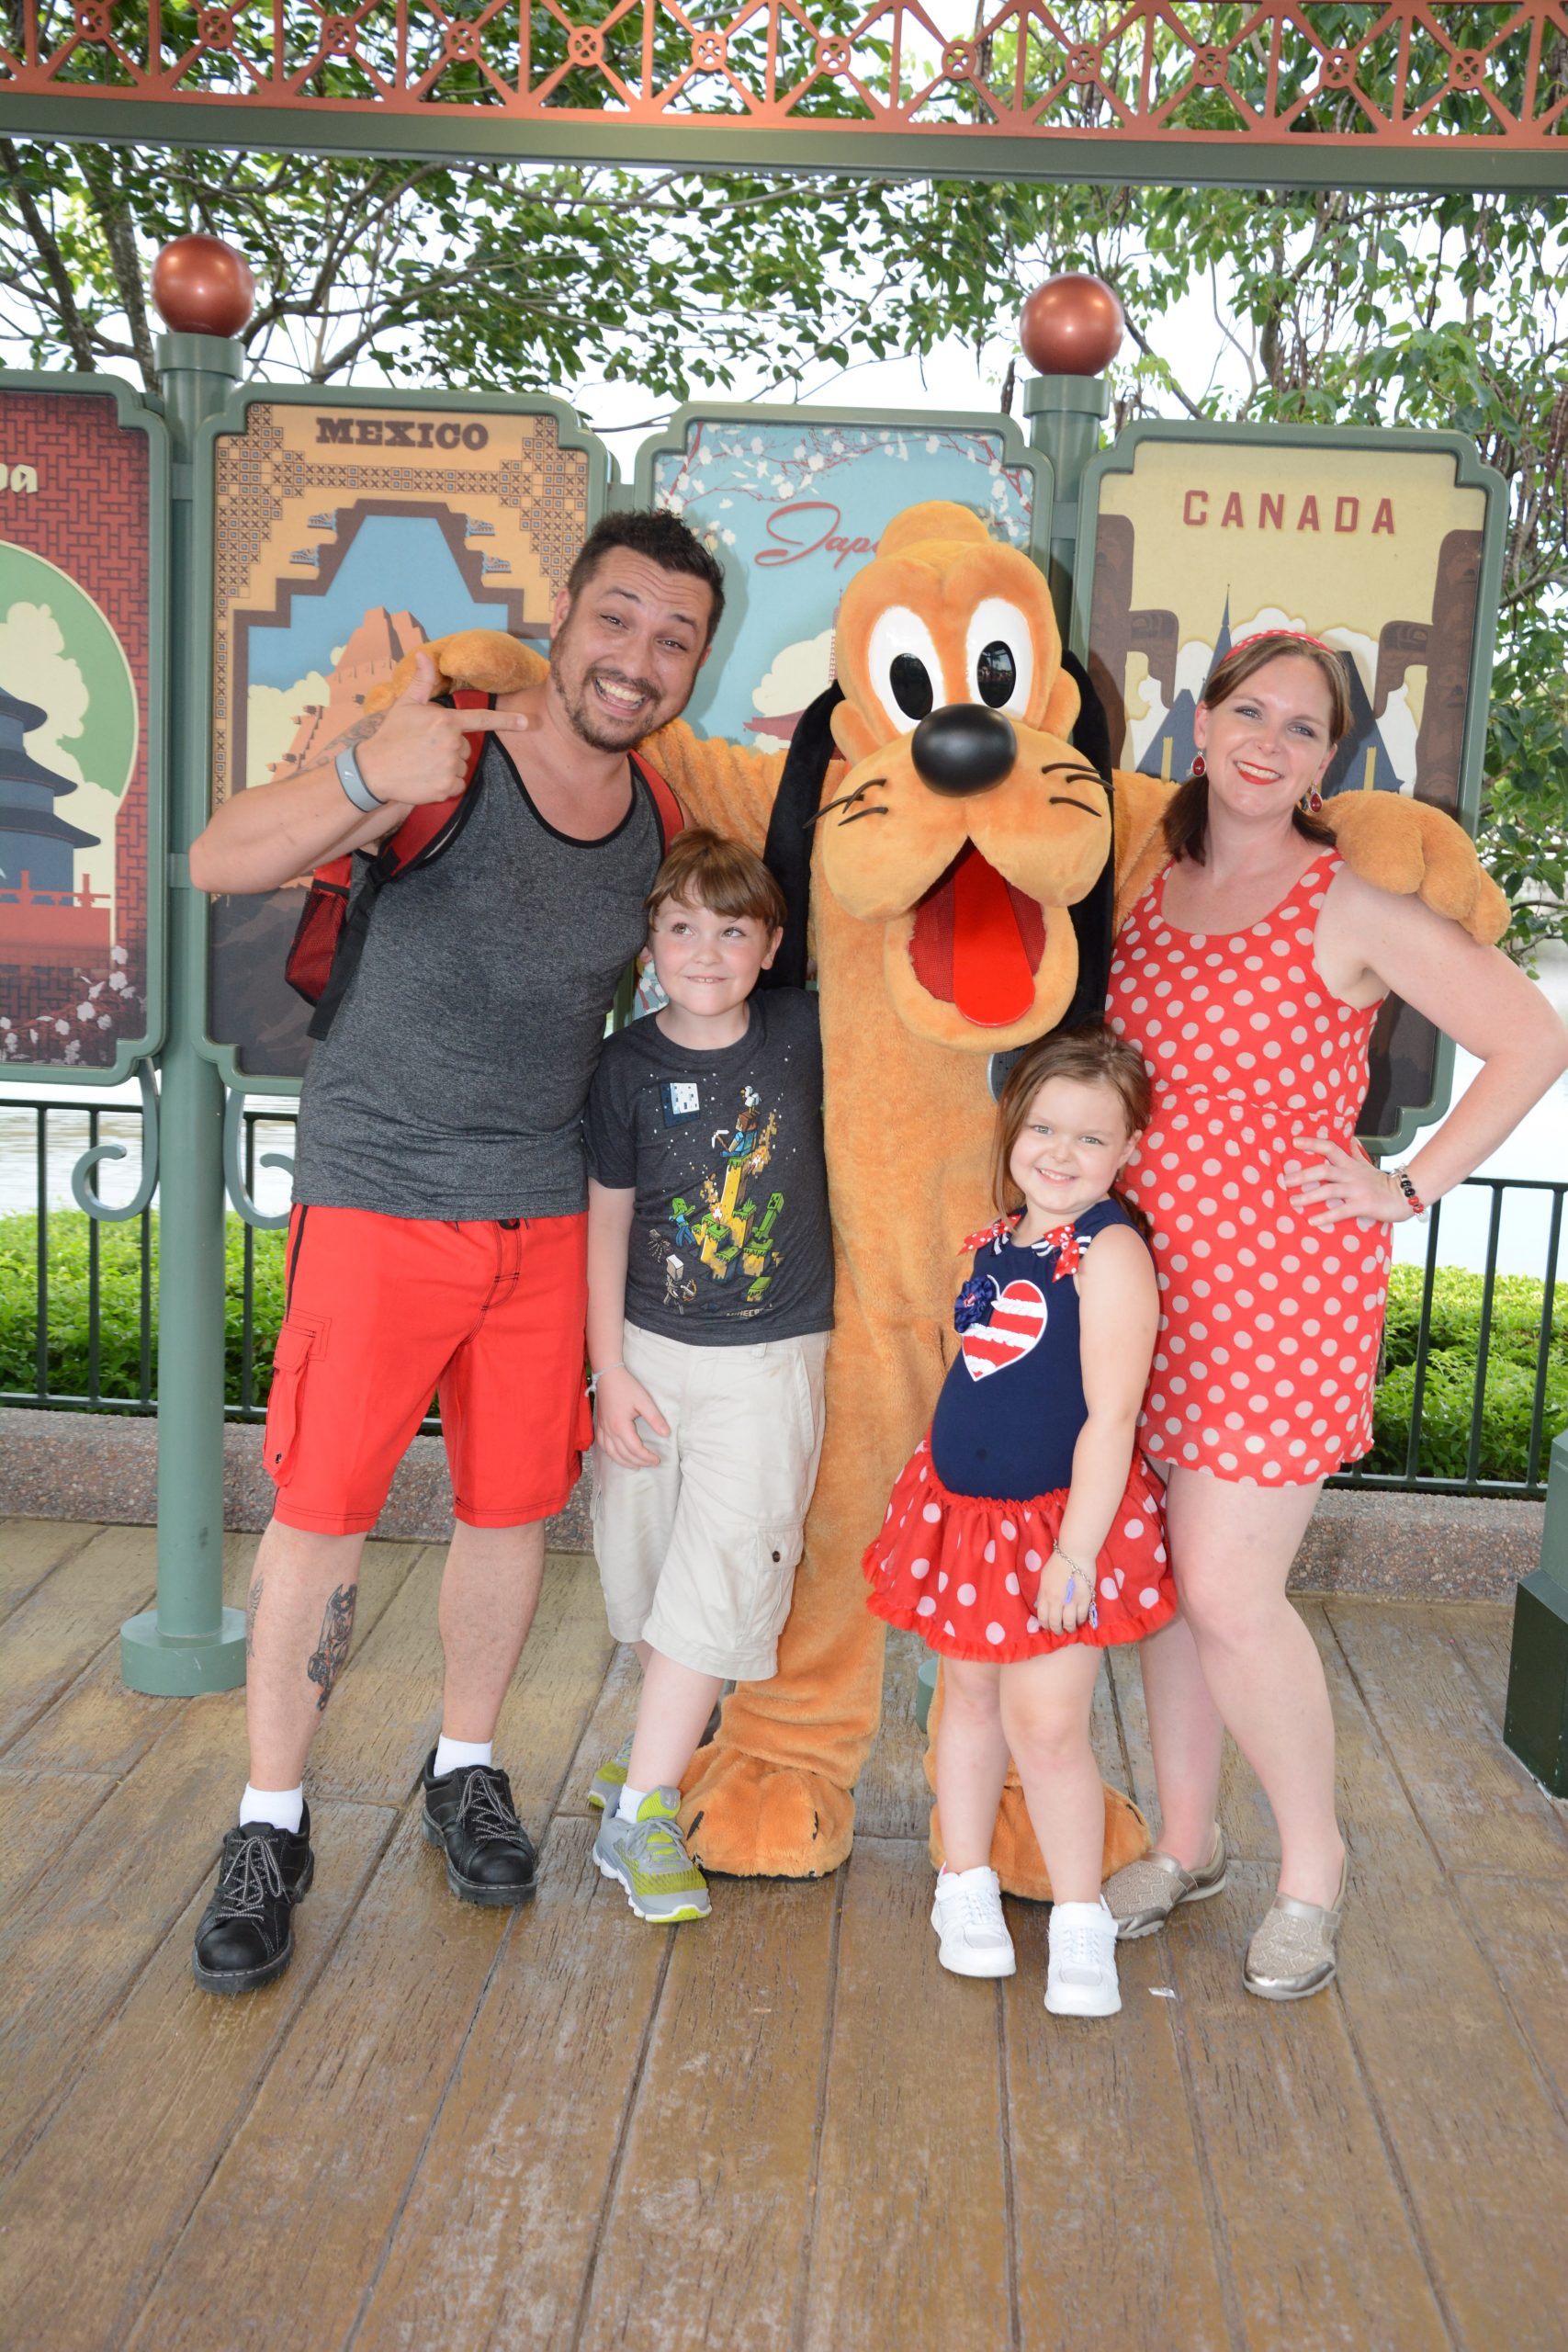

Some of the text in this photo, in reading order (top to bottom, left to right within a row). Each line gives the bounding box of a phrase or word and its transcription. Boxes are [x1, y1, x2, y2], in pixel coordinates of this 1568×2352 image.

[316, 417, 489, 451] MEXICO
[1183, 490, 1395, 535] CANADA
[754, 502, 880, 570] Jap
